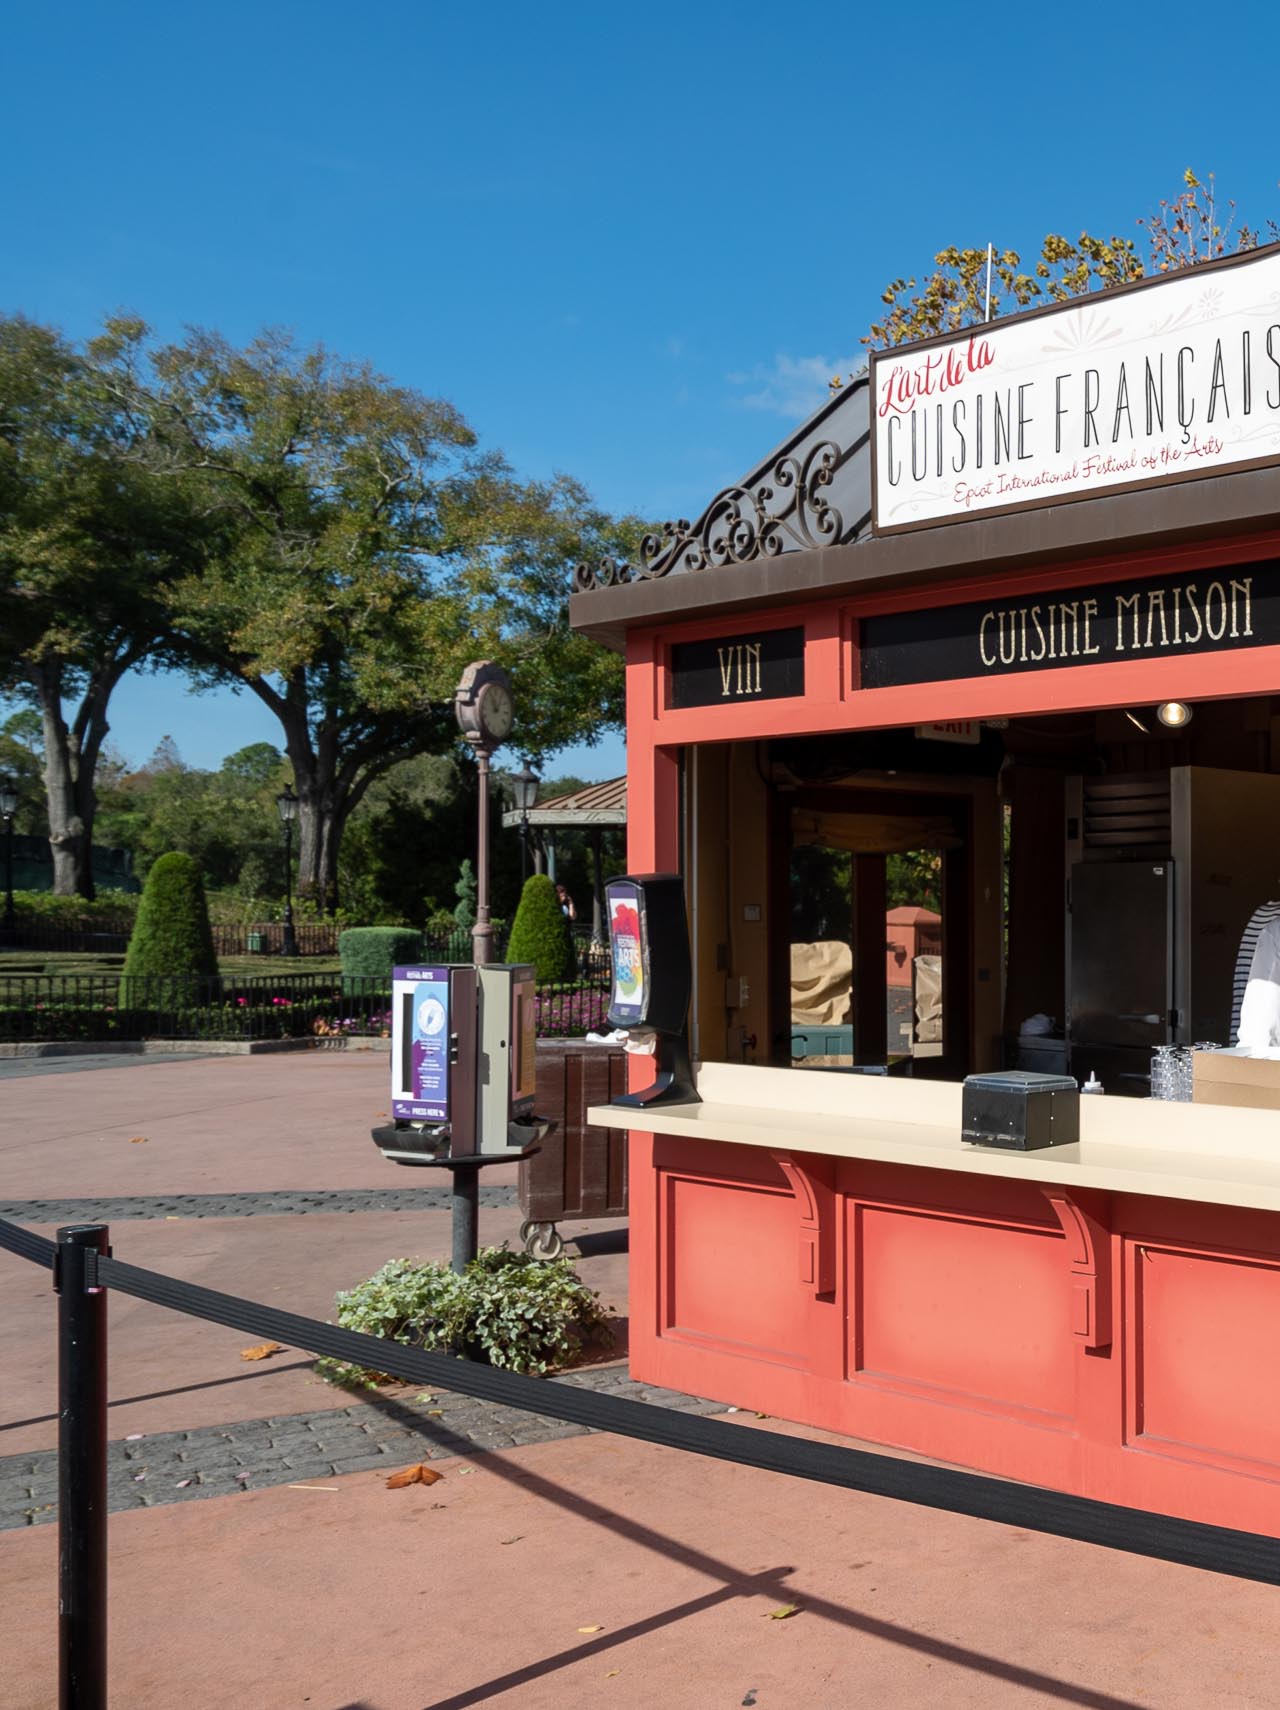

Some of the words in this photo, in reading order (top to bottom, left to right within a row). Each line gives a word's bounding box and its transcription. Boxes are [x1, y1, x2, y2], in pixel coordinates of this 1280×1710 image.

[879, 353, 943, 417] L'art
[939, 347, 965, 392] de
[966, 334, 995, 372] la
[888, 383, 1034, 487] CUISINE
[954, 481, 992, 507] Epcot
[996, 468, 1079, 494] International
[1082, 455, 1137, 479] Festival
[1141, 453, 1157, 469] of
[1160, 446, 1181, 465] the
[1184, 435, 1224, 461] Arts
[979, 599, 1099, 667] CUISINE
[1114, 578, 1254, 651] MAISON
[717, 643, 763, 696] VIN
